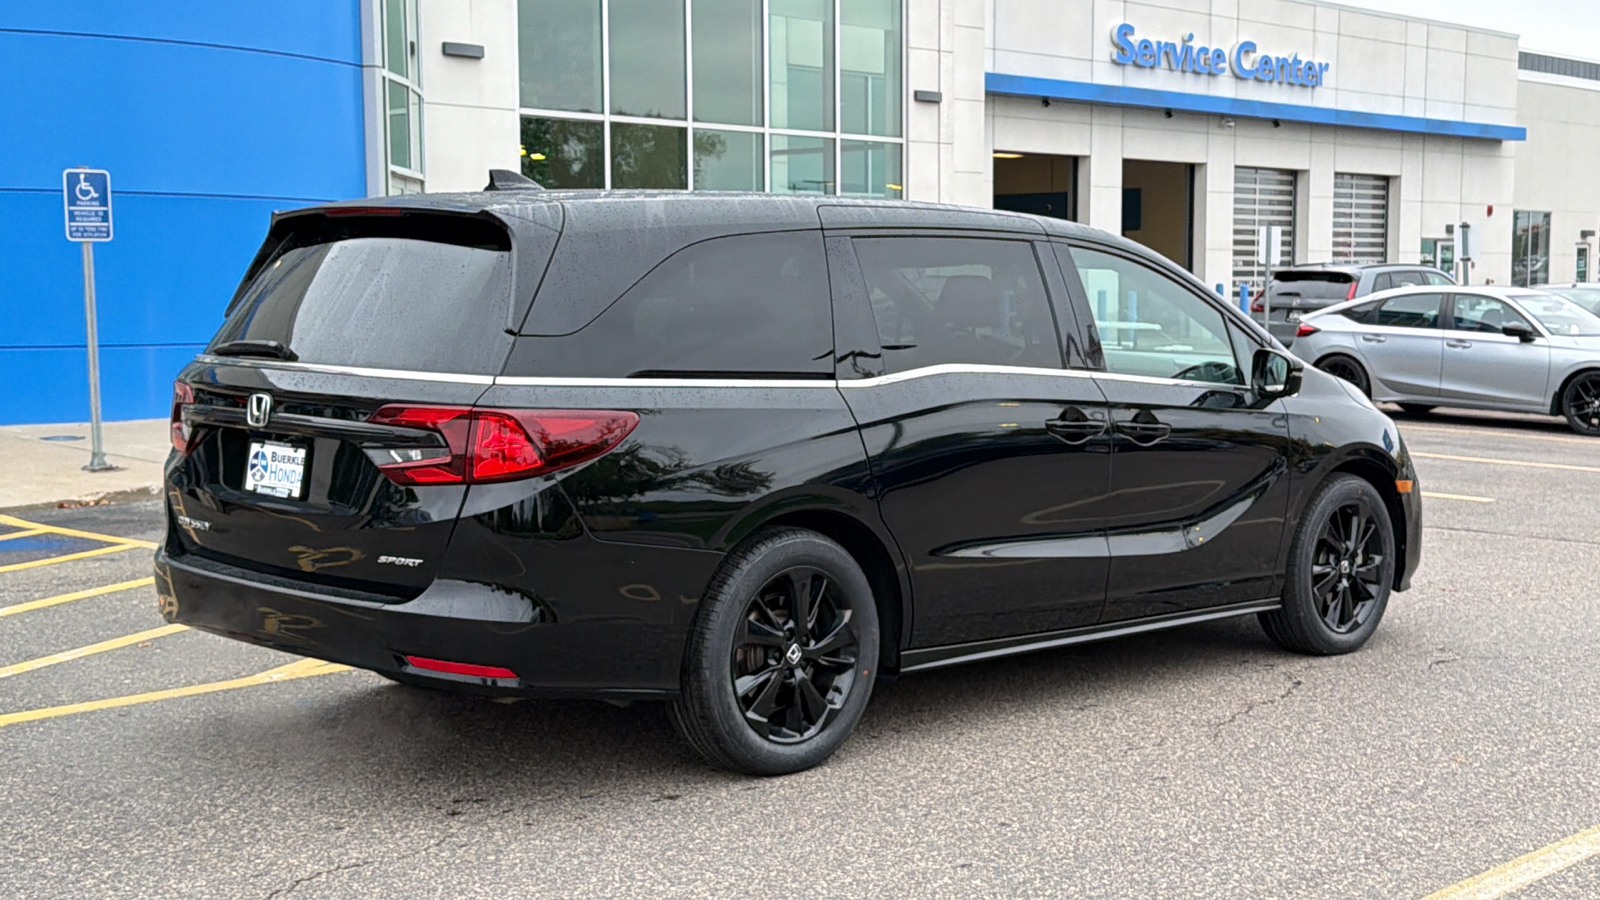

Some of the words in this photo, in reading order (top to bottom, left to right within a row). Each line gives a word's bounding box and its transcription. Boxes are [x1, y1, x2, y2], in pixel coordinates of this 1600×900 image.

[1112, 22, 1227, 75] Service
[1231, 40, 1330, 87] Center
[271, 451, 306, 466] BUERKLE
[269, 463, 304, 485] HONDA
[377, 555, 424, 567] SPORT
